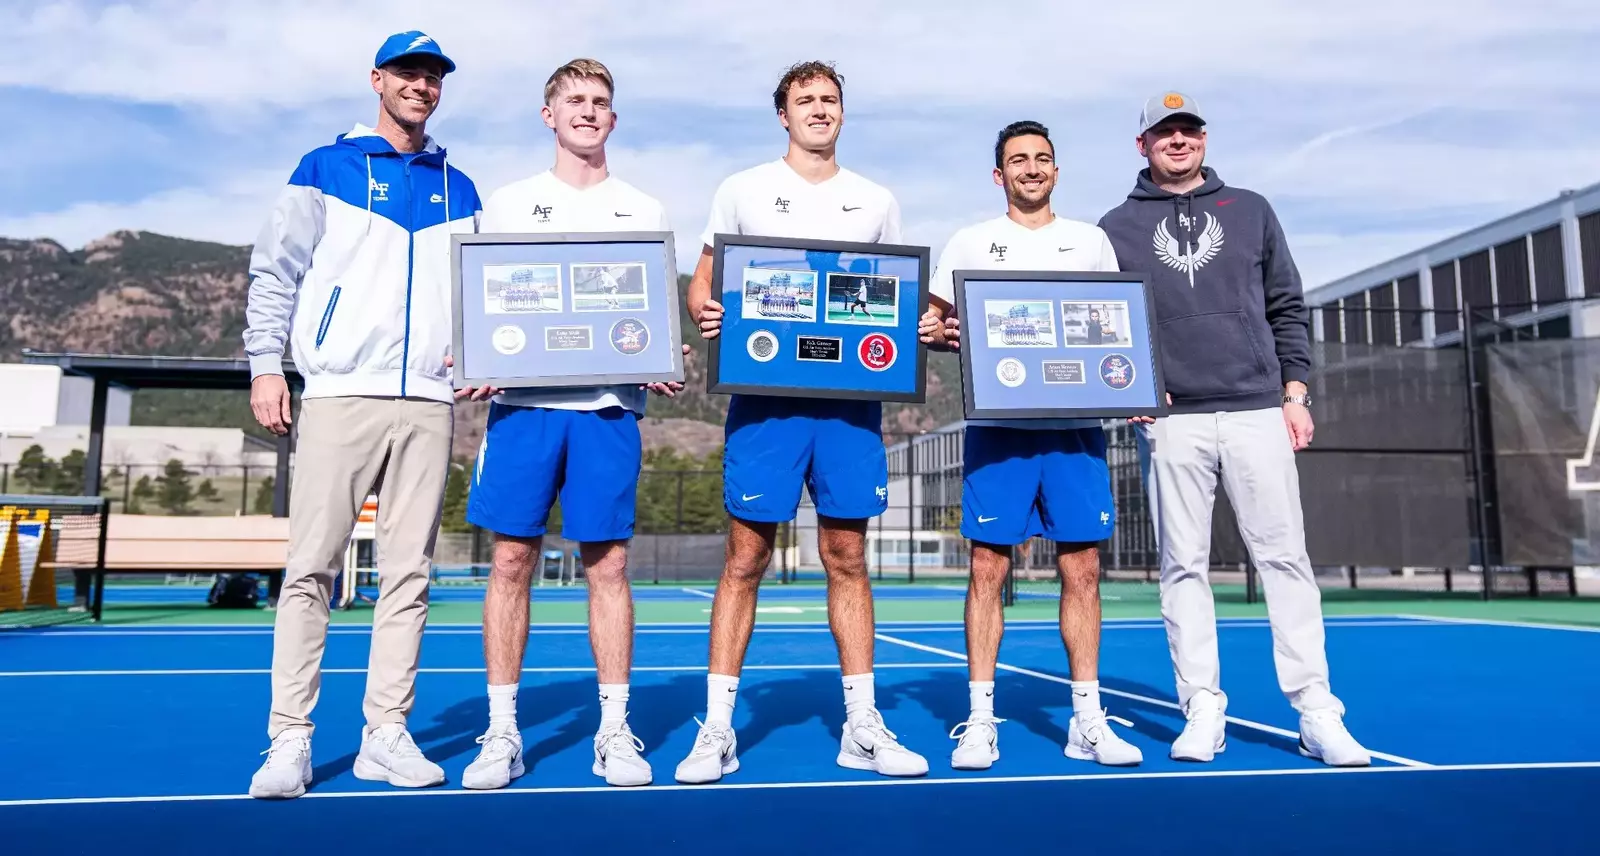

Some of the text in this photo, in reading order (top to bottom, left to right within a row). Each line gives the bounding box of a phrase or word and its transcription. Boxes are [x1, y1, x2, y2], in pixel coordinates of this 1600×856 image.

[370, 178, 389, 196] AF
[775, 197, 790, 209] AF
[532, 204, 552, 218] AF
[989, 242, 1007, 257] AF
